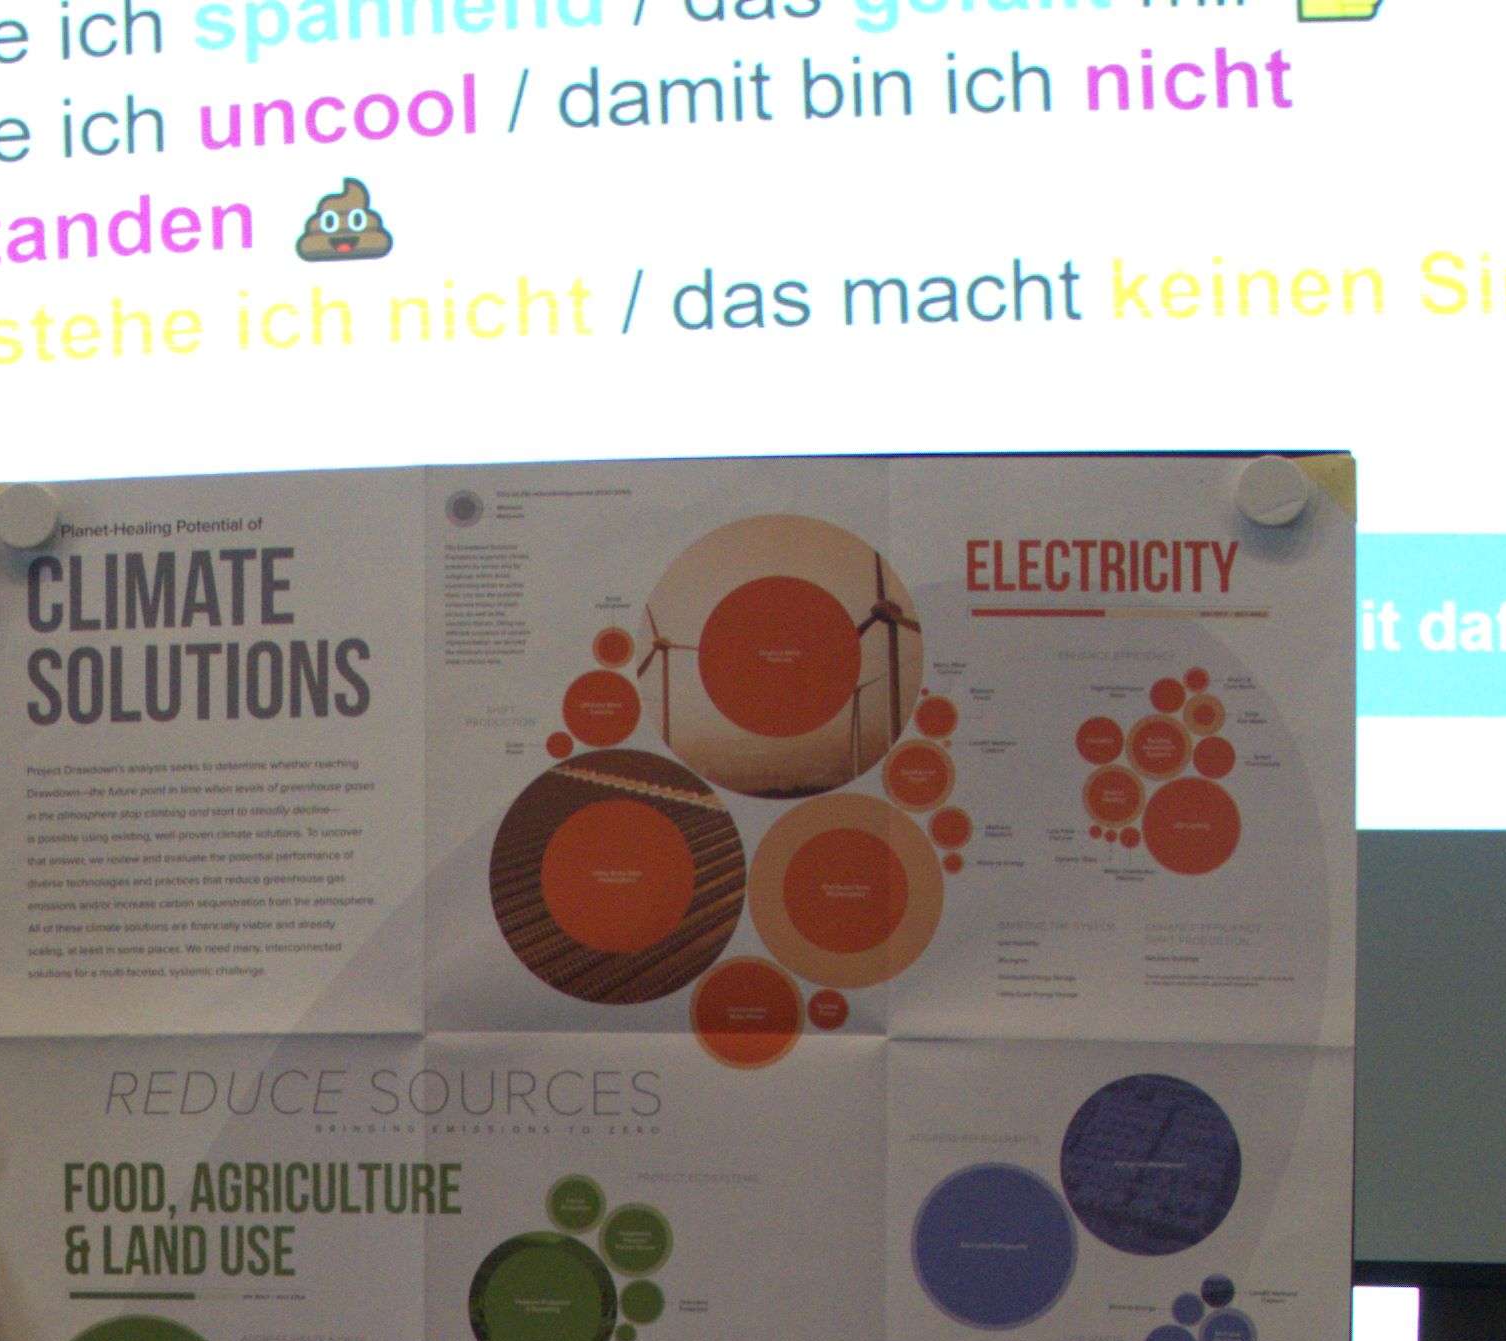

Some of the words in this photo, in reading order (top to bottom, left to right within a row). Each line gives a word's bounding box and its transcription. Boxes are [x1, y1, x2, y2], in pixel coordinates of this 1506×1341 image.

[59, 0, 164, 59] ich
[61, 95, 165, 159] ich
[200, 73, 478, 151] uncool
[507, 68, 529, 134] /
[558, 61, 772, 129] damit
[802, 59, 913, 120] bin
[945, 52, 1053, 115] ich
[1086, 48, 1293, 111] nicht
[236, 286, 353, 350] ich
[388, 274, 592, 338] nicht
[622, 270, 643, 334] /
[672, 268, 811, 330] das
[843, 259, 1082, 327] macht
[1111, 258, 1385, 320] keinen
[61, 520, 172, 539] Planet-Healing
[176, 518, 240, 535] Potential
[245, 517, 263, 532] of
[27, 547, 295, 632] CLIMATE
[965, 538, 1239, 594] ELECTRICITY
[26, 638, 371, 726] SOLUTIONS
[105, 1069, 347, 1116] REDUCE
[370, 1069, 662, 1116] SOURCES
[314, 1123, 417, 1135] BRINGING
[432, 1123, 551, 1135] EMISSIONS
[568, 1124, 591, 1135] TO
[608, 1125, 662, 1136] ZERO
[63, 1162, 176, 1219] FOOD,
[190, 1161, 462, 1216] AGRICULTURE
[65, 1228, 91, 1276] &
[102, 1224, 207, 1277] LAND
[221, 1224, 296, 1277] USE
